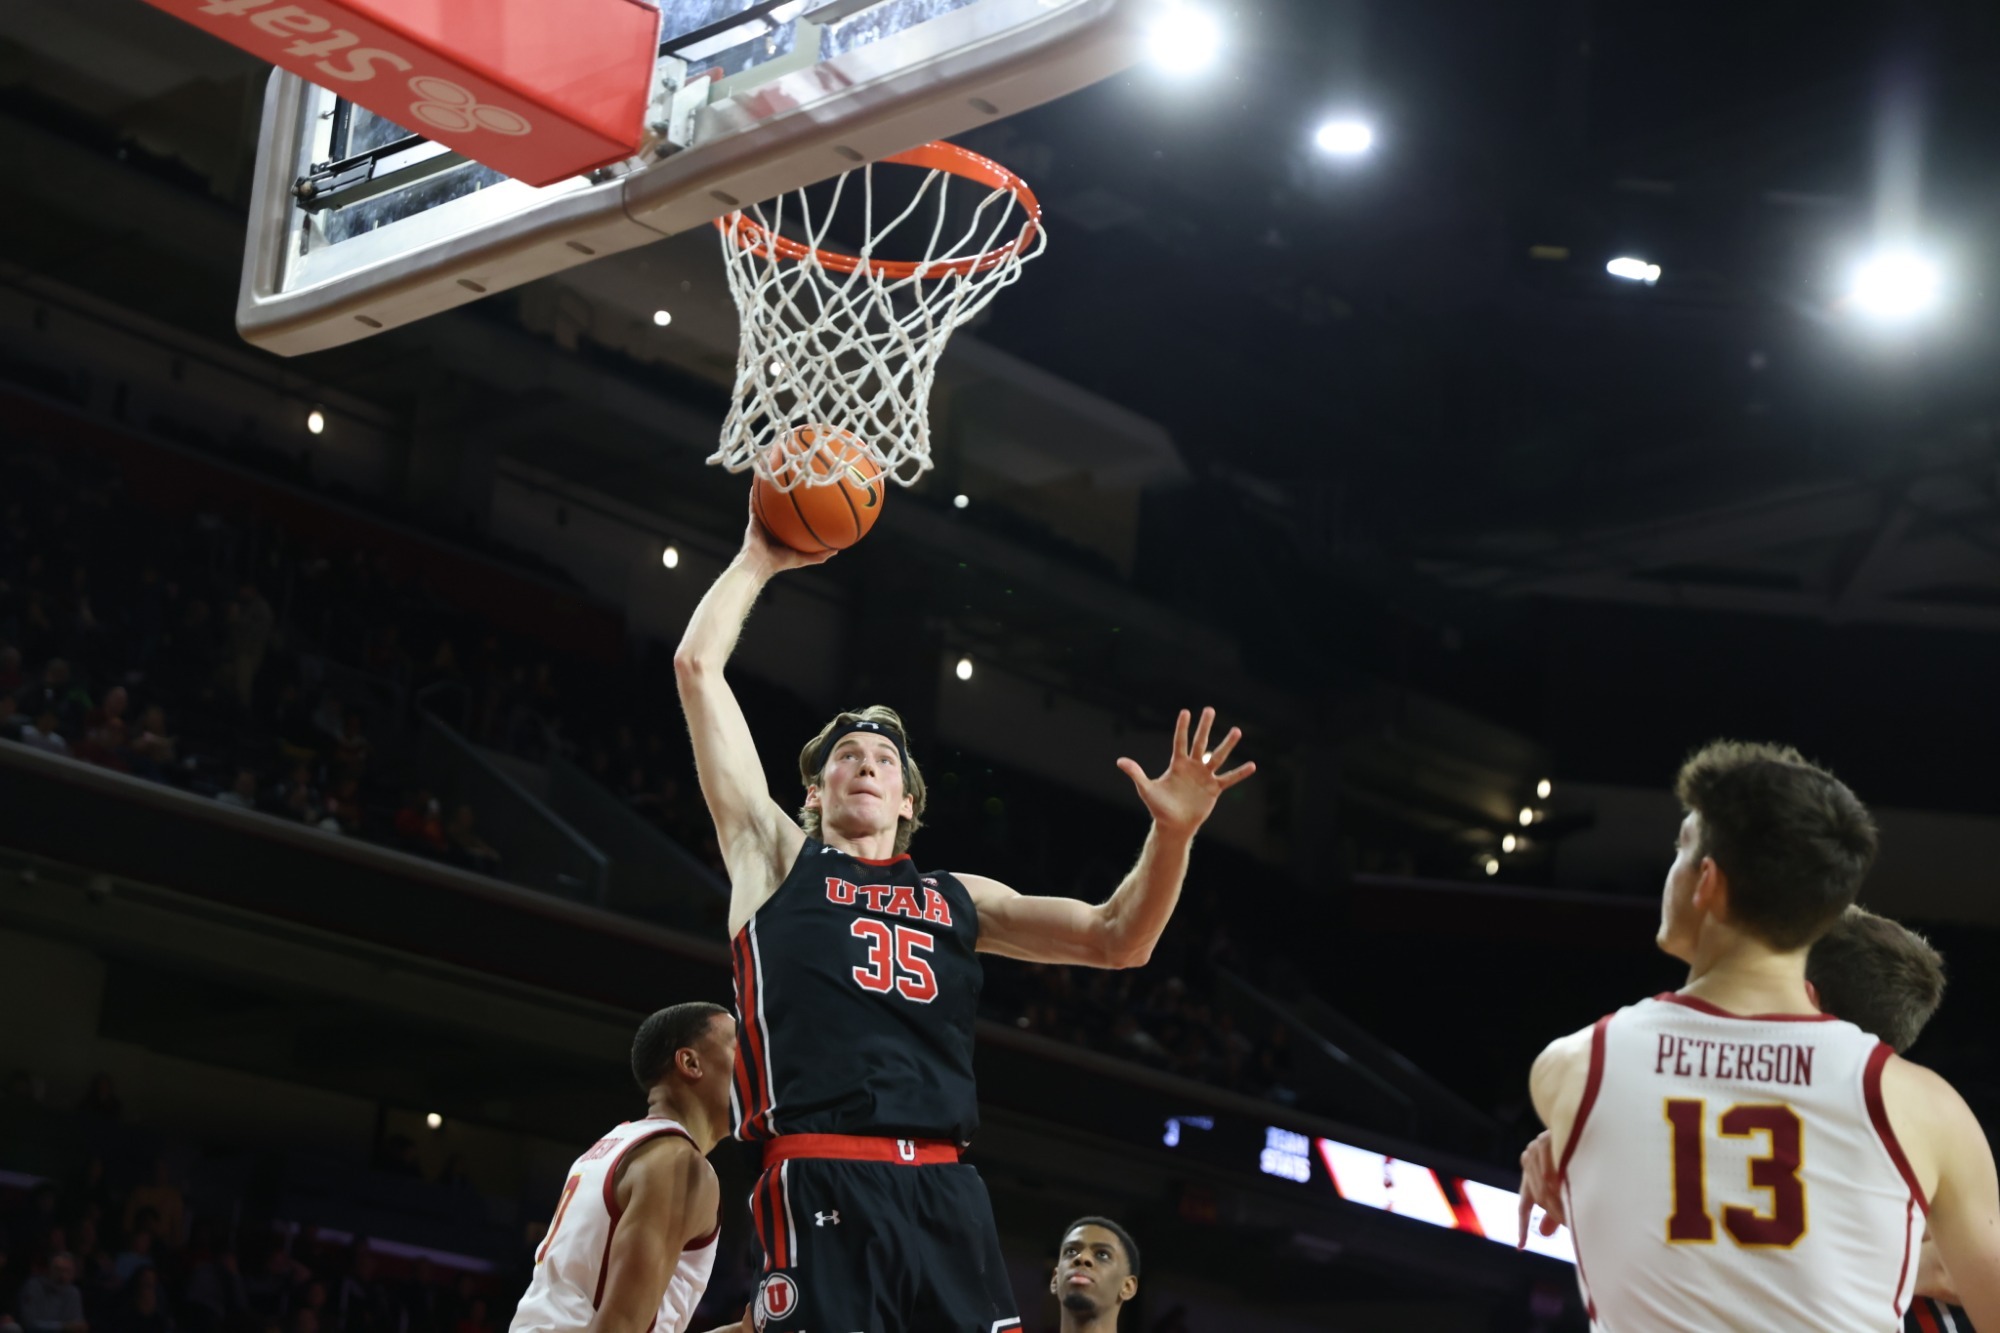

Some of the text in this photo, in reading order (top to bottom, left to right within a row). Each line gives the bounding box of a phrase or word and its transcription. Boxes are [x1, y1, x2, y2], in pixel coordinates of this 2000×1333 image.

[825, 876, 953, 927] UTAH
[850, 917, 938, 1003] 35
[1655, 1033, 1815, 1087] PETERSON
[897, 1139, 915, 1161] U
[1663, 1096, 1809, 1250] 13
[767, 1282, 788, 1314] U
